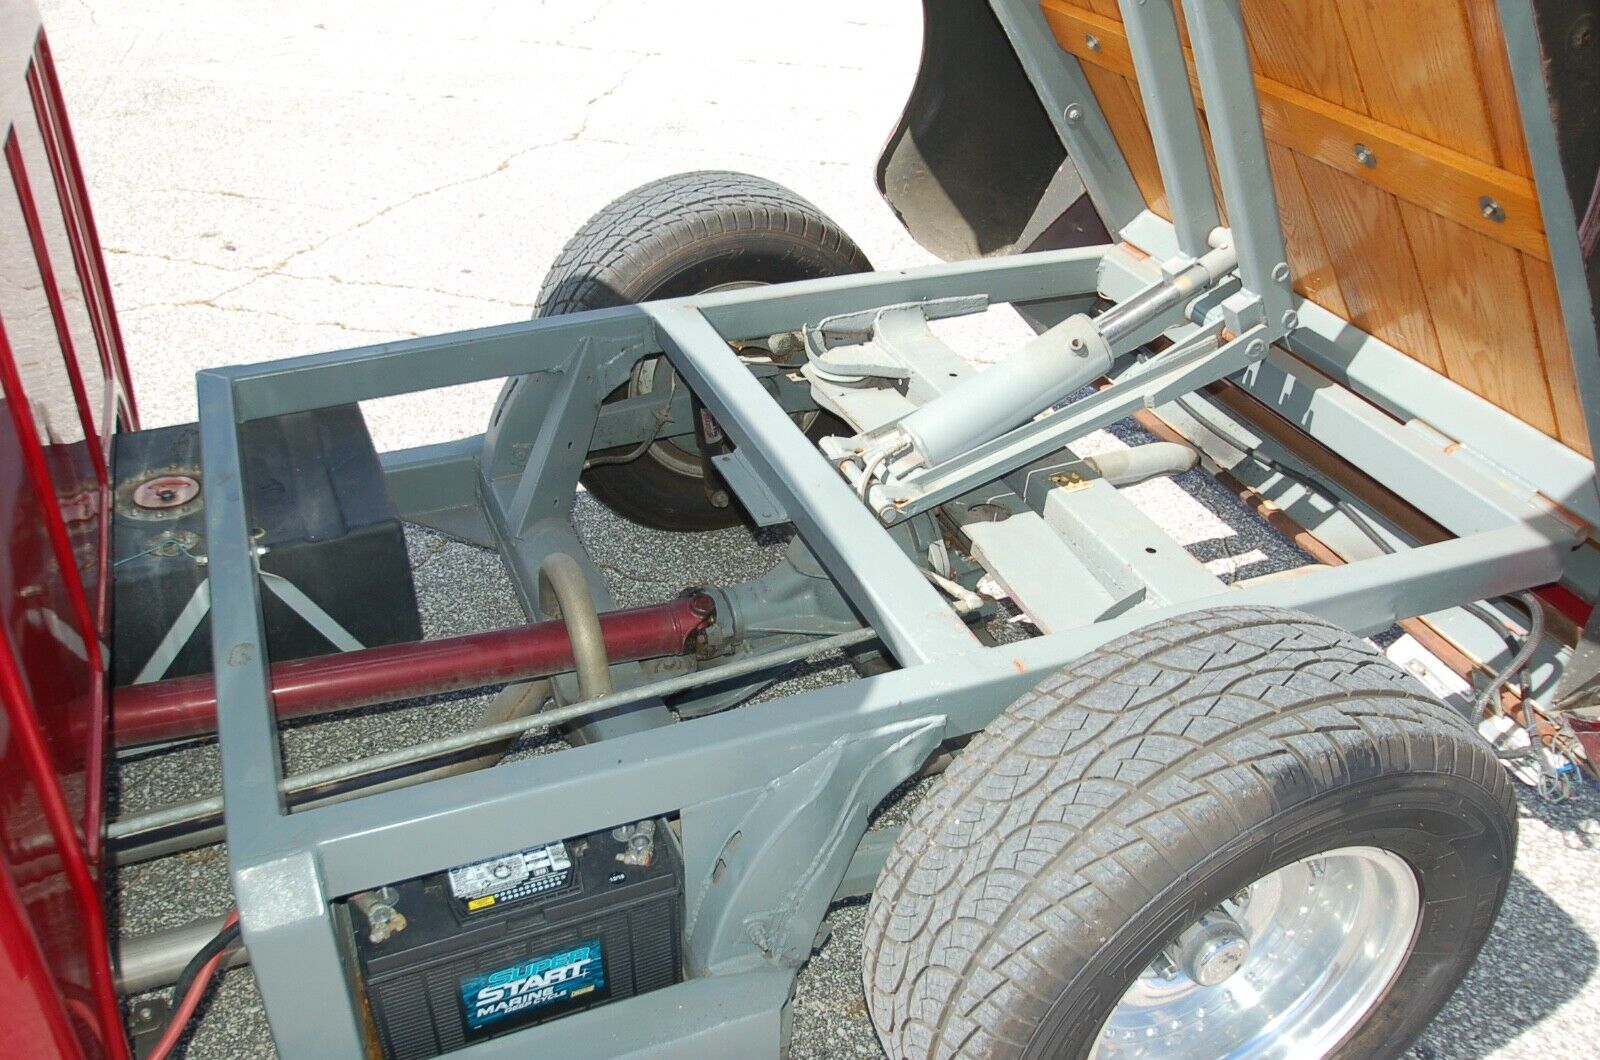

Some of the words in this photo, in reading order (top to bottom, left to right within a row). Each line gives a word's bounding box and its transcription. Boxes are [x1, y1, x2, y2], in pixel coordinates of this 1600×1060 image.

[488, 947, 590, 984] SUPER
[476, 958, 592, 1008] START
[533, 990, 567, 1004] CYCLE
[477, 986, 554, 1018] MARINE
